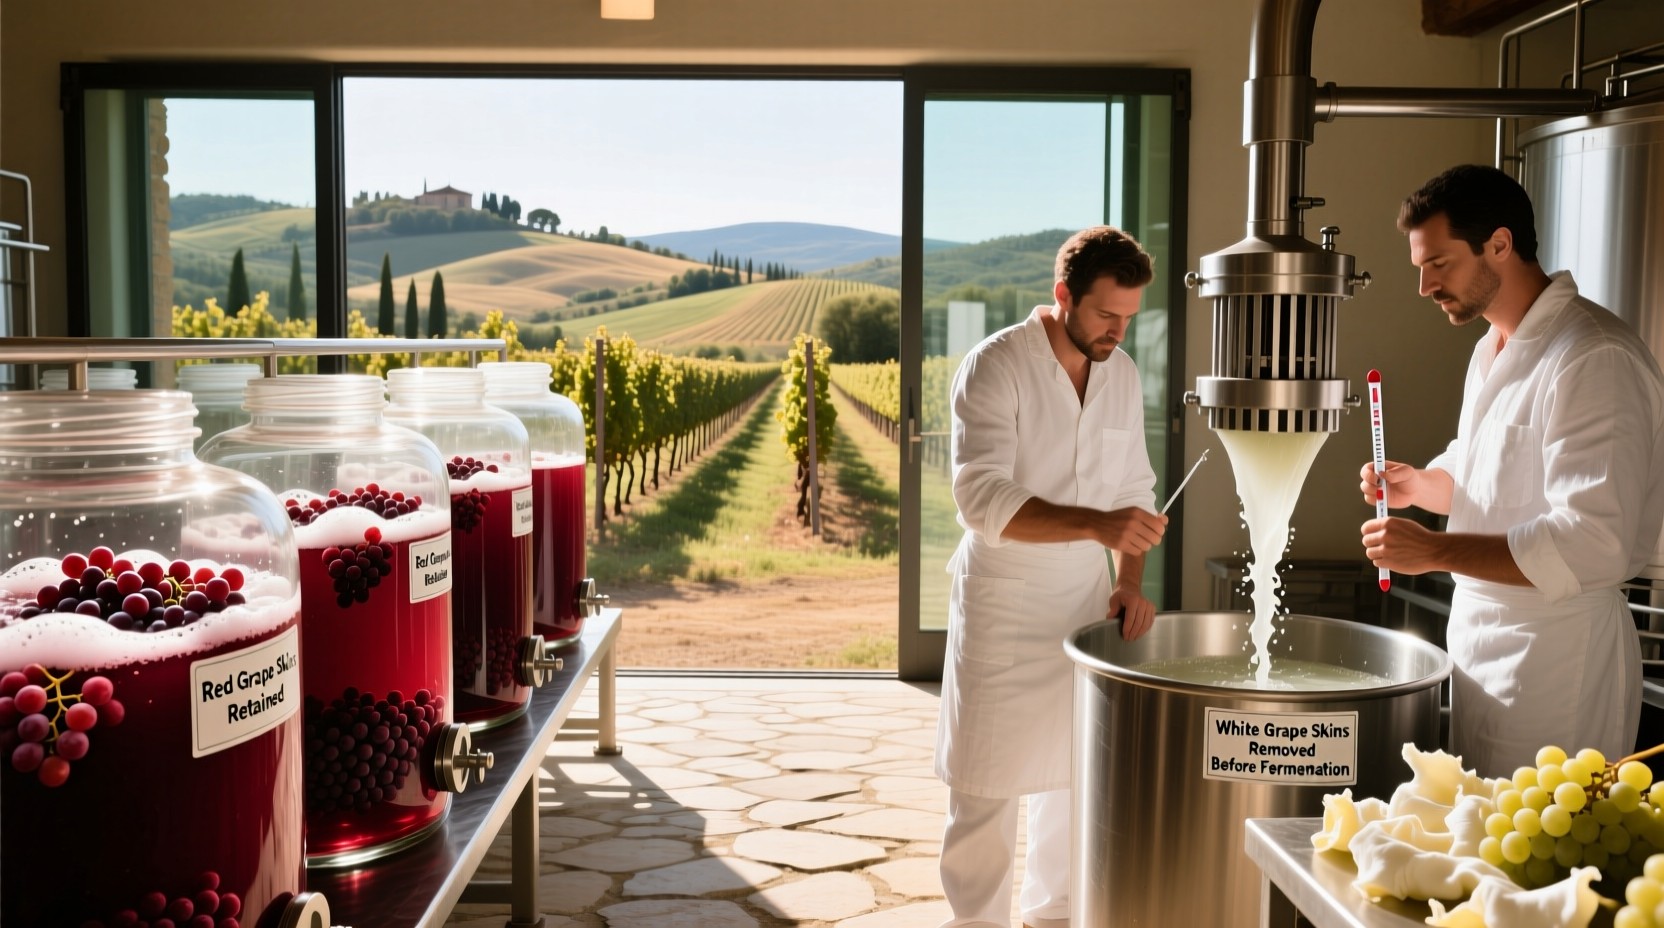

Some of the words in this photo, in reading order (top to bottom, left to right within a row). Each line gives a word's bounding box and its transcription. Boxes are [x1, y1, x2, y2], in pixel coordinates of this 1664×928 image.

[202, 674, 233, 703] Red
[237, 666, 274, 690] Grape
[228, 683, 285, 724] Retained
[1216, 719, 1259, 736] White
[1264, 723, 1308, 741] Grape
[1311, 723, 1350, 738] Skins
[1249, 741, 1316, 757] Removed
[1211, 756, 1257, 773] Before
[1260, 760, 1350, 776] Fermenation
